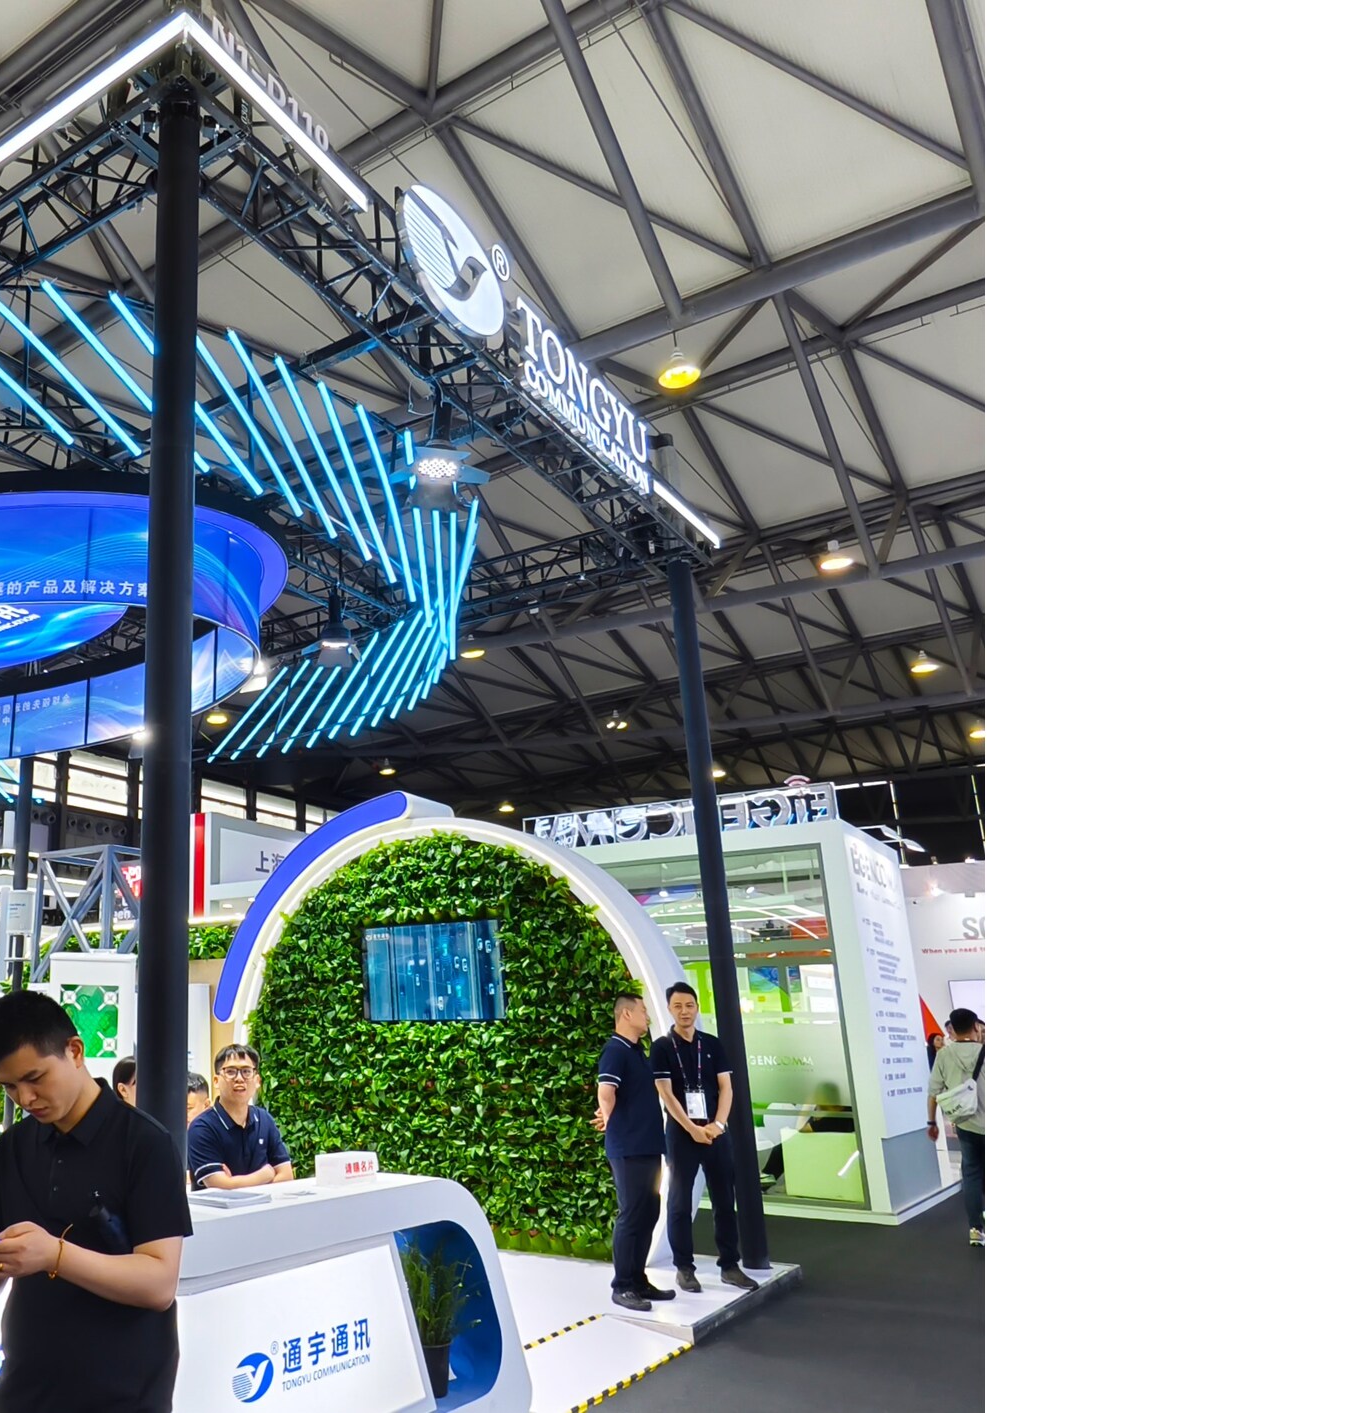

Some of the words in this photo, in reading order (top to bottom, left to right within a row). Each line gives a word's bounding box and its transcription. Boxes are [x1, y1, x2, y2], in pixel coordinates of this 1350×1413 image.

[212, 15, 329, 152] N1-D110
[516, 296, 647, 463] TONGYU
[523, 359, 650, 494] COMMUNICATION
[281, 1372, 312, 1392] TONGYU
[313, 1353, 371, 1382] COMMUNICATION
[282, 1318, 371, 1375] 通宇通讯
